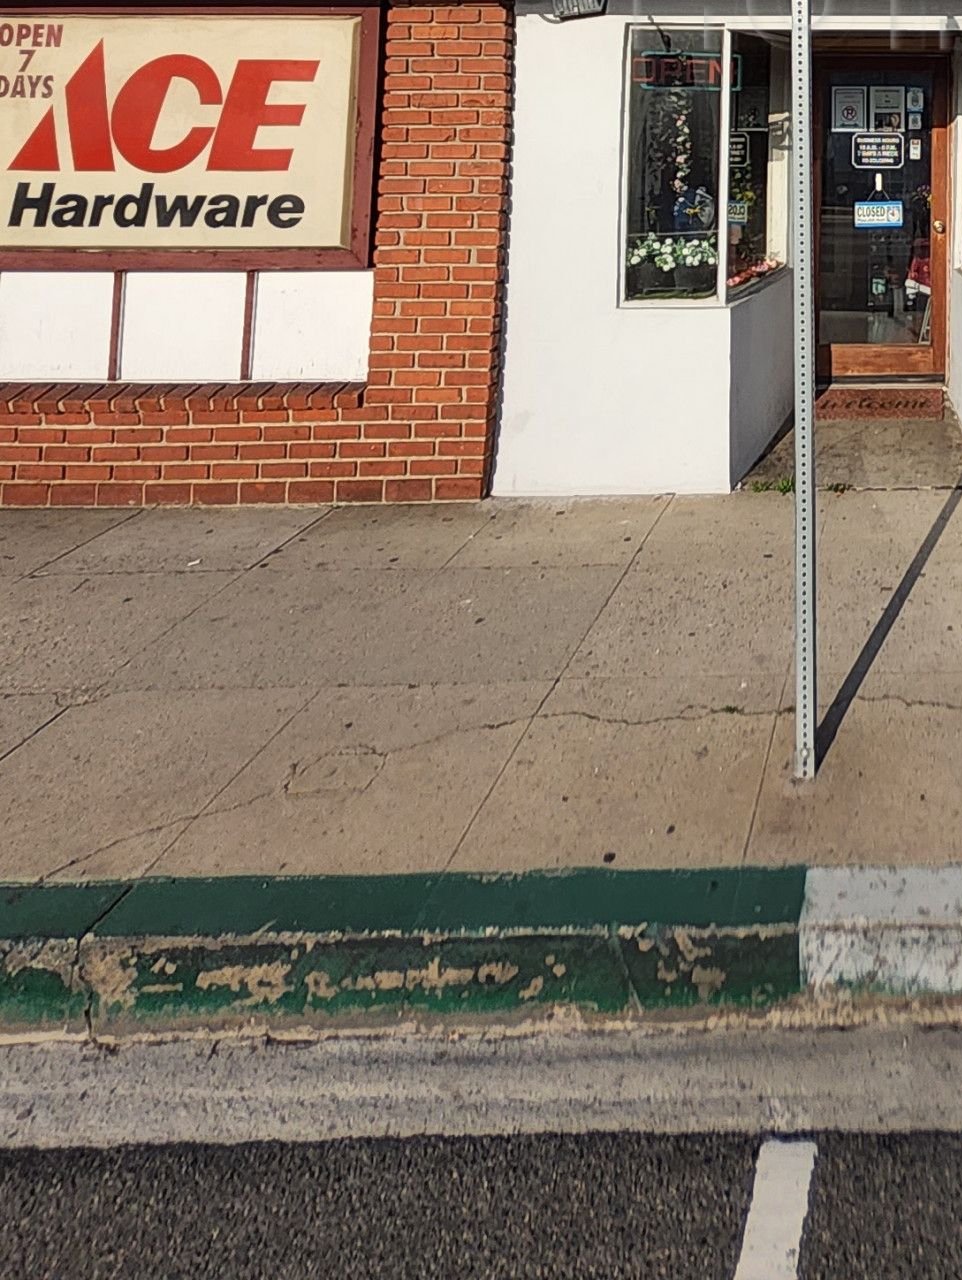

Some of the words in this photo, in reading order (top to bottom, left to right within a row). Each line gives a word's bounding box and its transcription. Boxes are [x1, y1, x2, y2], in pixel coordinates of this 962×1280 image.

[0, 23, 63, 47] OPEN
[18, 49, 36, 72] 7
[0, 75, 54, 98] DAYS
[7, 37, 320, 173] ACE
[8, 182, 305, 228] Hardware
[857, 206, 885, 218] CLOSED
